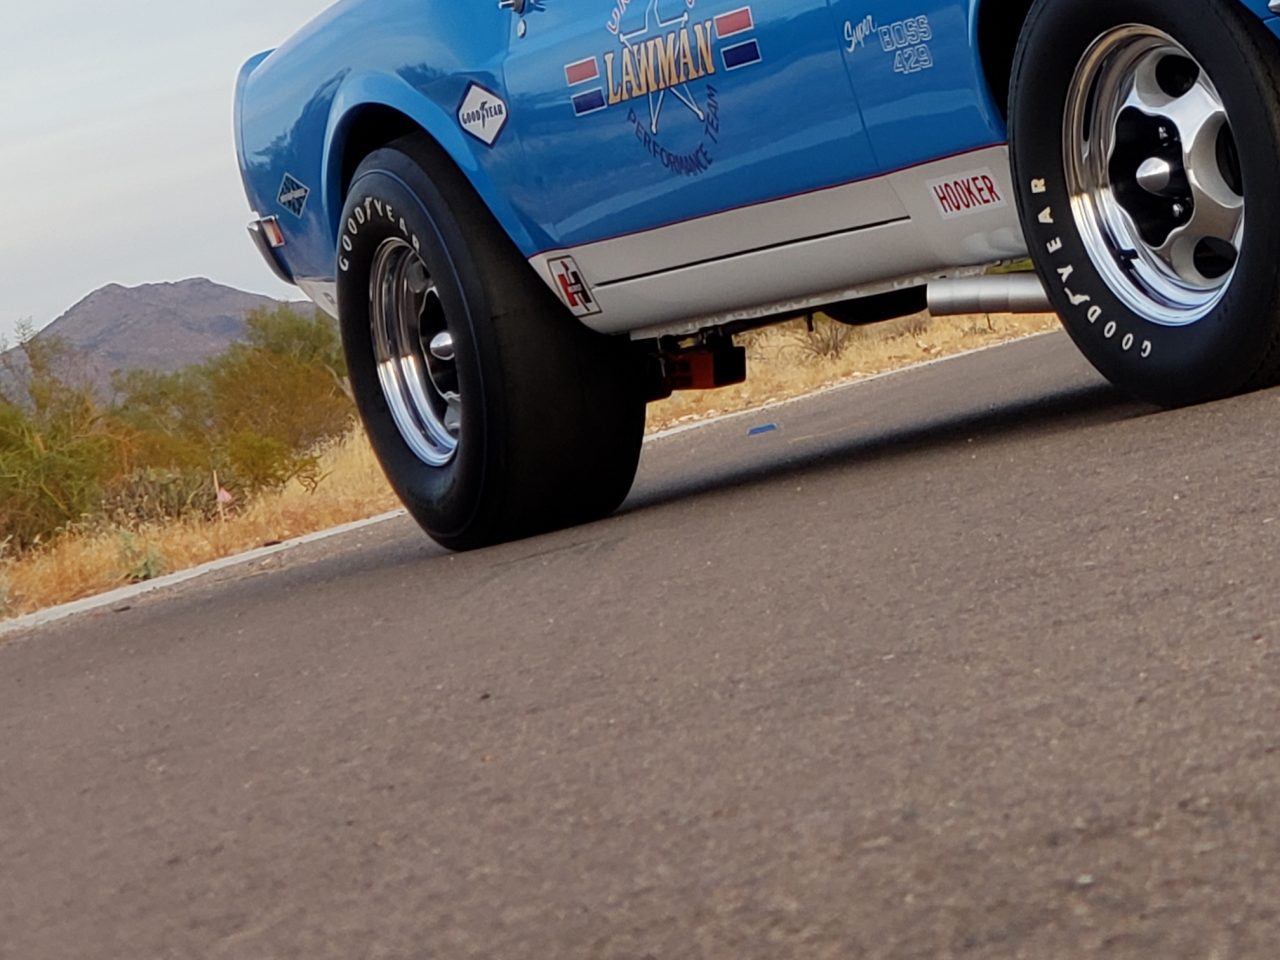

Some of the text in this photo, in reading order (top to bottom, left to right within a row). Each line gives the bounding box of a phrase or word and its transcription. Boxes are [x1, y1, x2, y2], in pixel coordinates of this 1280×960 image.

[604, 20, 716, 106] LAWMAN
[844, 15, 932, 53] Super BOSS
[893, 43, 933, 74] 429
[461, 100, 504, 129] GOODYEAR
[626, 84, 721, 177] PERFORMANCE TEAM
[933, 174, 1001, 214] HOOKER
[338, 196, 420, 272] GOODYEAR
[1031, 177, 1151, 358] GOODYEAR
